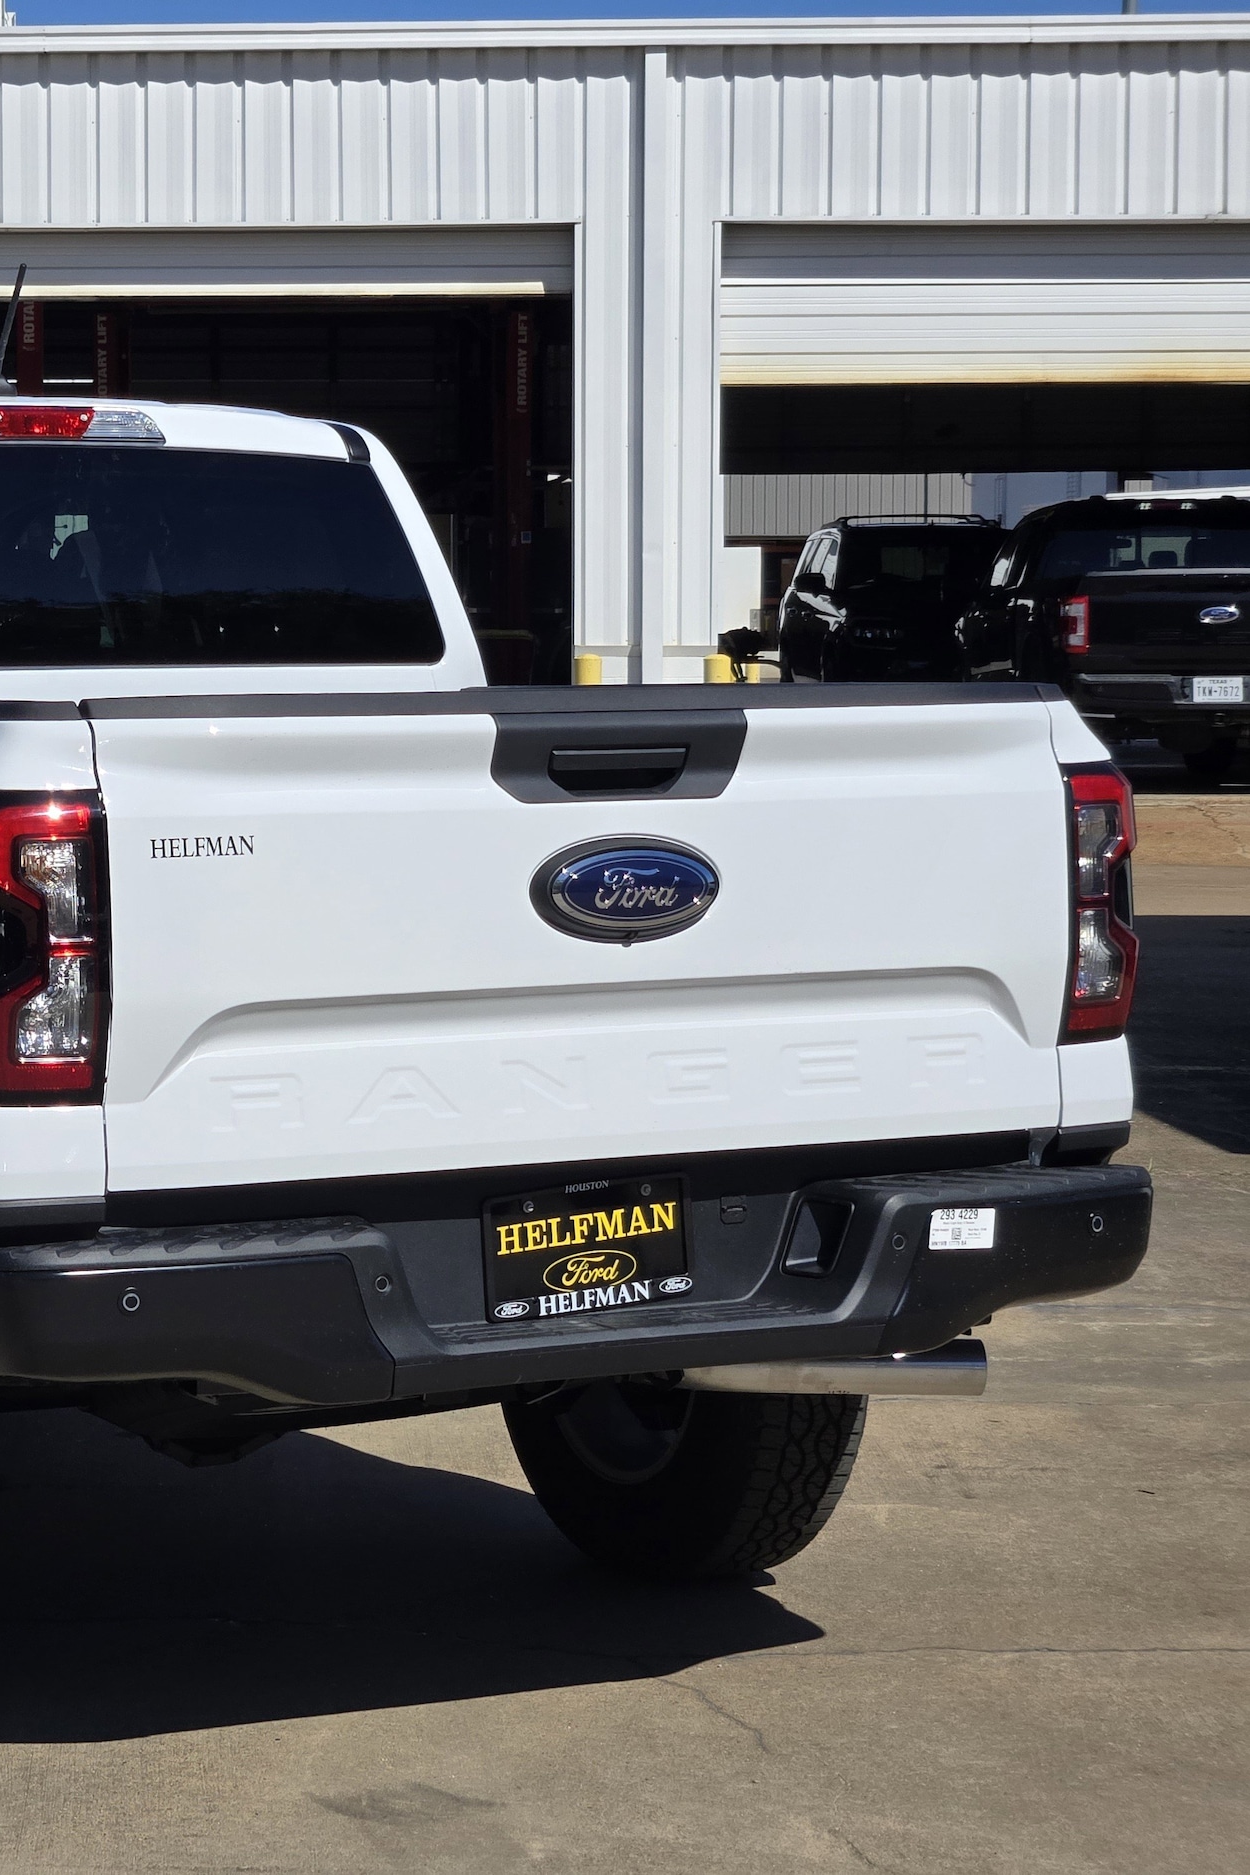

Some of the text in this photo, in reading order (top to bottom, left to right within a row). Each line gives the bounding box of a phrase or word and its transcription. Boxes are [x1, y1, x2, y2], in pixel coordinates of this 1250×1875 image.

[97, 315, 108, 398] OTARY LIFT
[517, 314, 528, 406] ROTARY LIFT
[150, 835, 255, 859] HELFMAN
[595, 867, 680, 909] Ford
[209, 1031, 988, 1133] RANGER
[565, 1179, 610, 1194] HOUSTON
[496, 1201, 677, 1256] HELFMAN
[940, 1208, 979, 1220] 293 4229
[561, 1255, 620, 1287] Ford
[500, 1278, 687, 1316] Ford HELFMAN Ford
